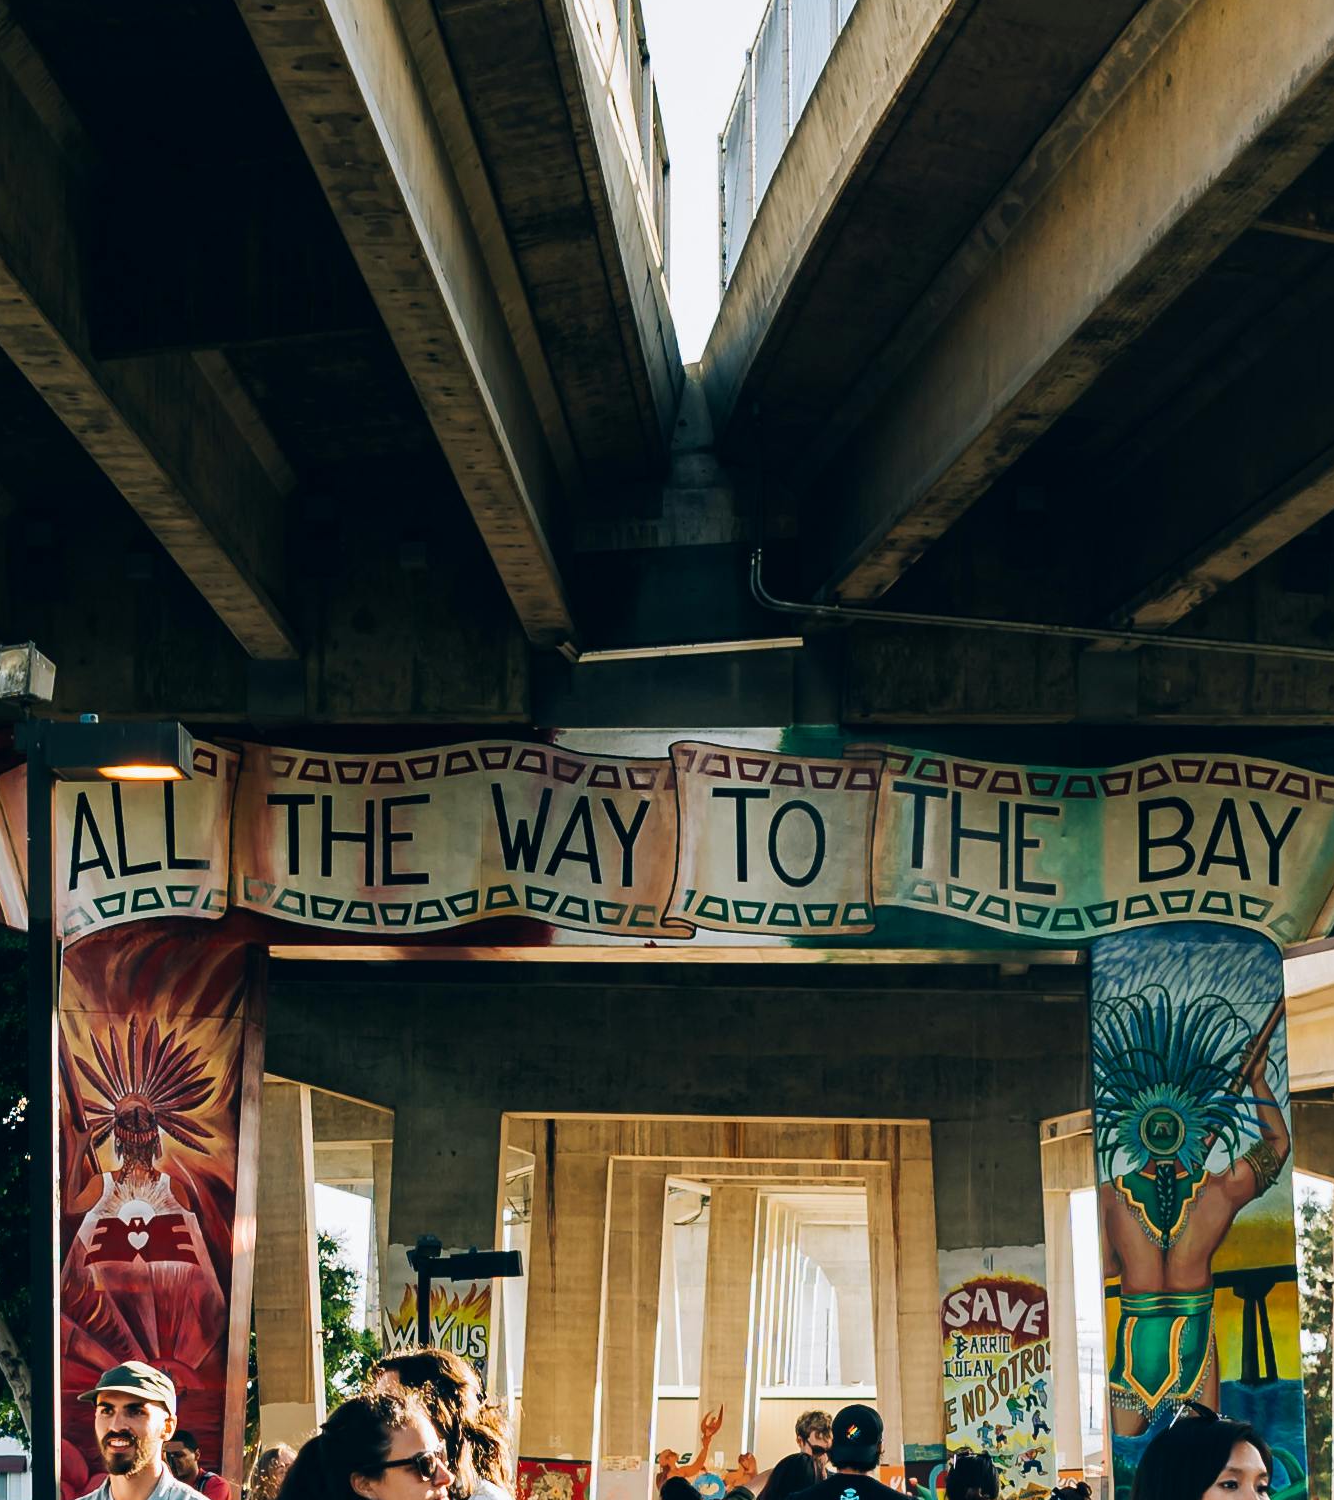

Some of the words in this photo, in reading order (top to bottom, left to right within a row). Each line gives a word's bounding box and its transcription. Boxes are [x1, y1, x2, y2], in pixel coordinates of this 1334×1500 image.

[69, 780, 210, 890] ALL
[268, 793, 430, 887] THE
[491, 783, 650, 887] WAY
[712, 787, 826, 888] TO
[893, 782, 1064, 896] THE
[1137, 796, 1302, 887] BAY
[384, 1306, 456, 1354] WY
[451, 1322, 486, 1359] US
[944, 1287, 1045, 1335] SAVE
[951, 1331, 1011, 1359] BARRIO
[943, 1358, 993, 1382] LOGAN
